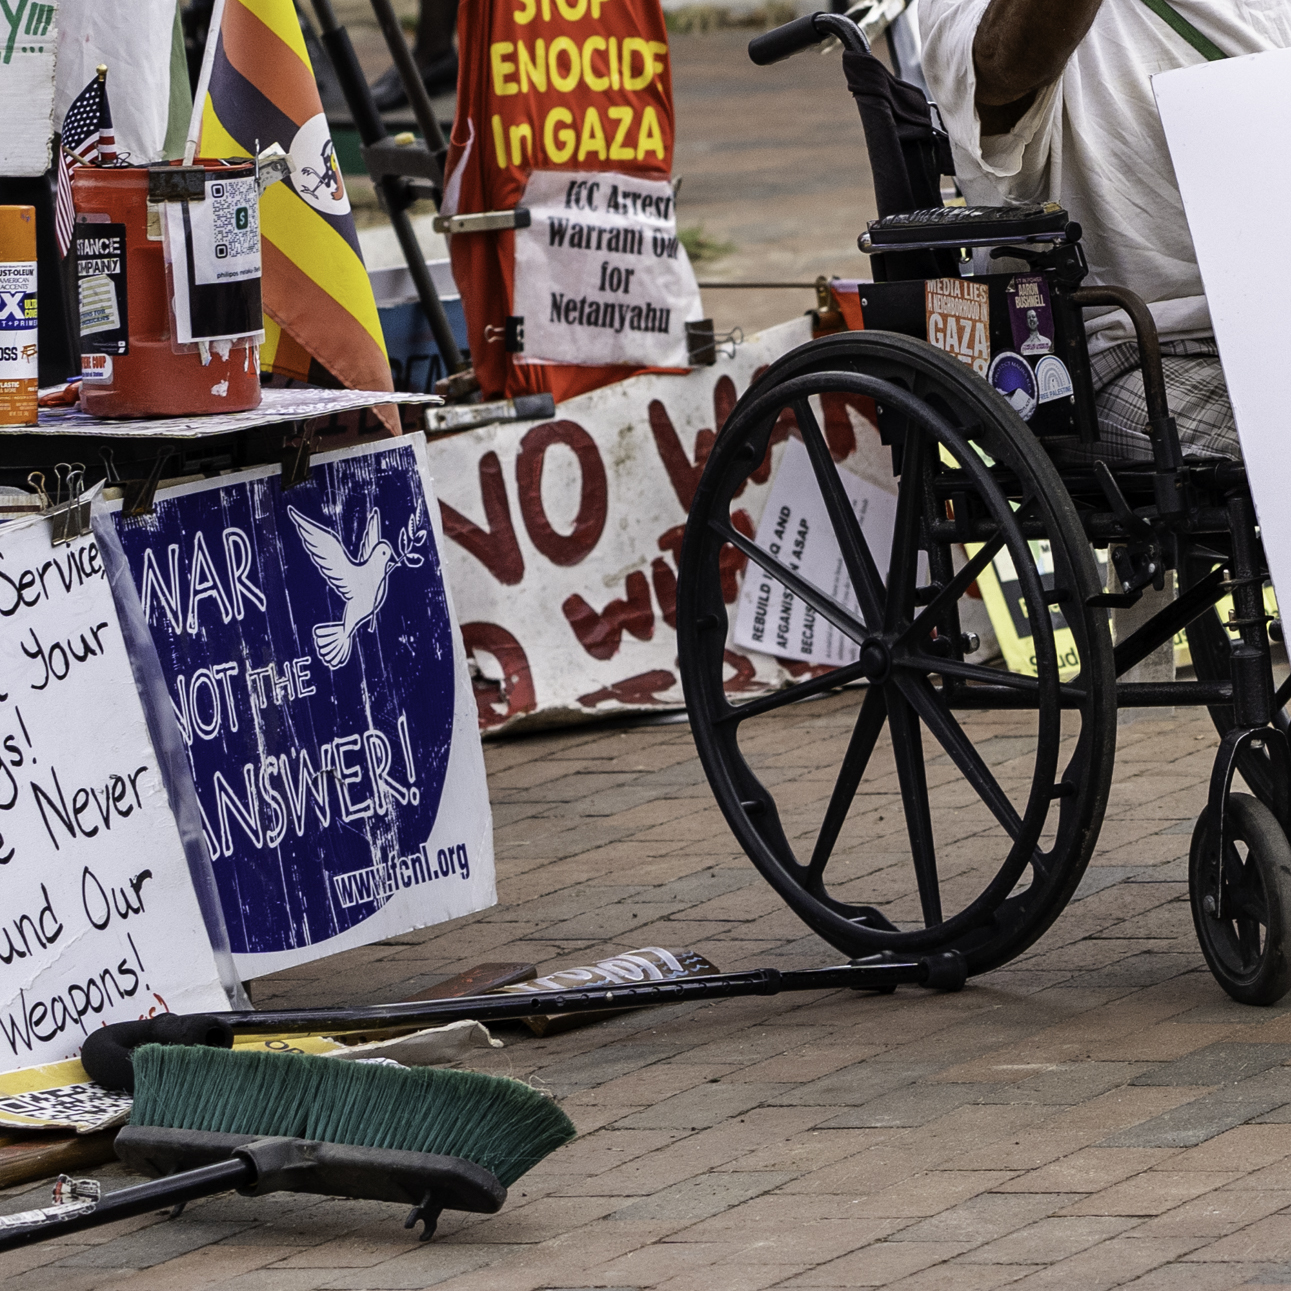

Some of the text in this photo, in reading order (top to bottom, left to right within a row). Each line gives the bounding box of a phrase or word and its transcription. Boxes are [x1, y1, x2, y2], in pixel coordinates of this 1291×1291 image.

[491, 105, 665, 169] In GAZA
[565, 180, 672, 221] ICC Arrest
[548, 216, 679, 260] Warrant Ou
[598, 261, 635, 294] for
[927, 279, 987, 302] MEDIA LIES
[1018, 282, 1039, 296] AARON
[549, 292, 671, 335] Netanyahu
[928, 293, 988, 322] A NEIGHBORHOOD IN
[1014, 294, 1046, 309] BUSHNELL
[928, 313, 988, 359] GAZA
[994, 361, 1011, 383] PROTECT
[1049, 385, 1072, 396] PALESTINE
[751, 583, 771, 643] REBUILD
[773, 504, 791, 541] AND
[776, 518, 810, 650] AFGANISN ASAP
[800, 606, 816, 655] BECAUS
[247, 656, 317, 709] THE
[30, 765, 149, 851] Never
[333, 841, 471, 909] www.fcnl.org
[82, 866, 153, 930] Our
[0, 932, 151, 1056] Weapons!
